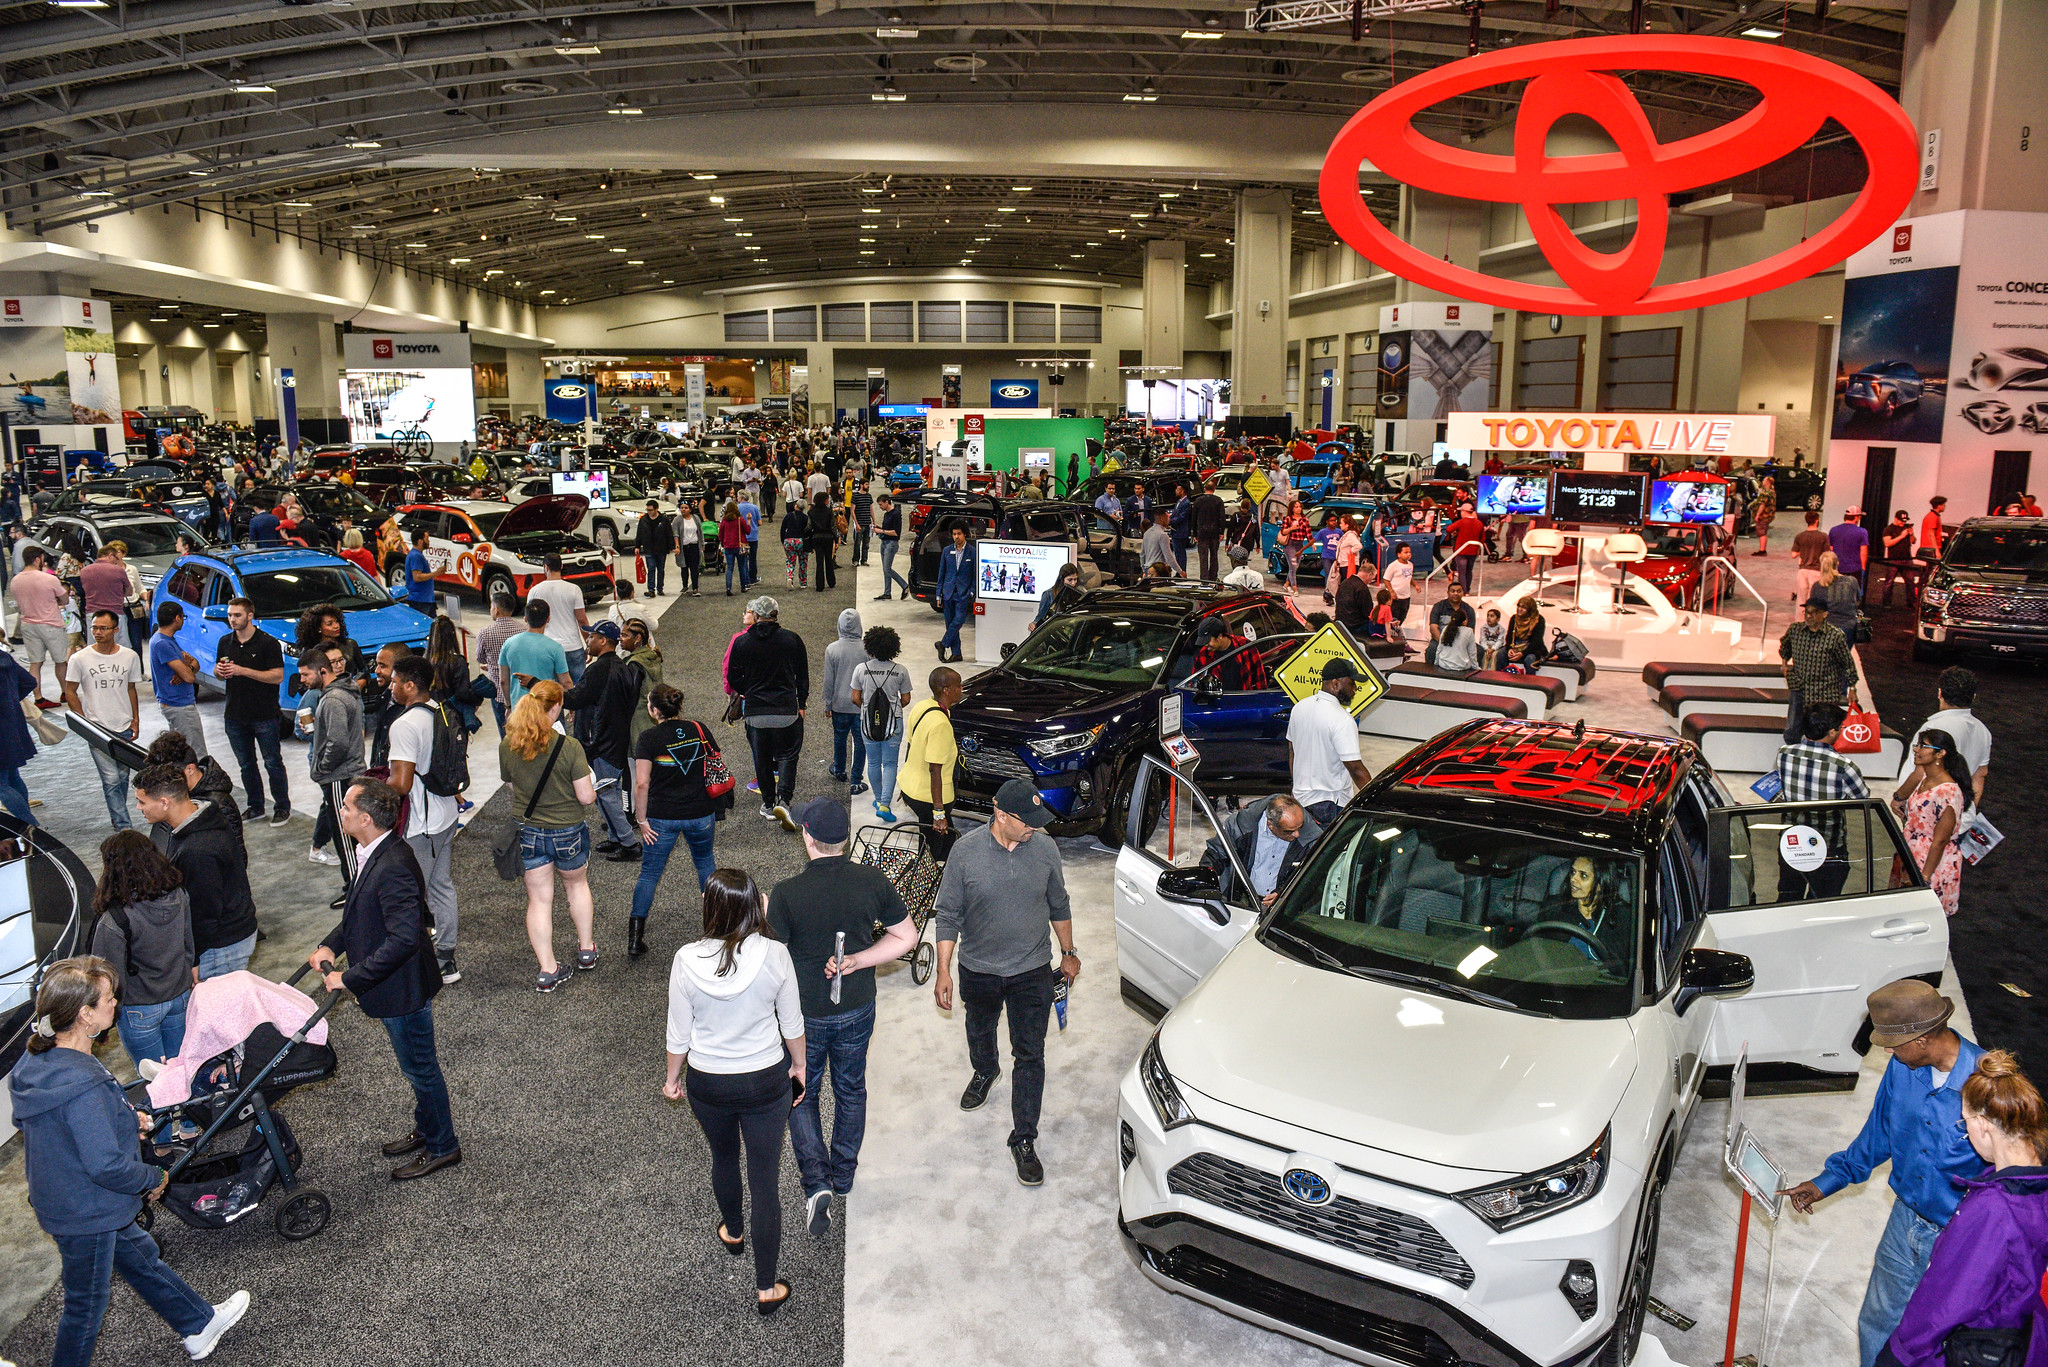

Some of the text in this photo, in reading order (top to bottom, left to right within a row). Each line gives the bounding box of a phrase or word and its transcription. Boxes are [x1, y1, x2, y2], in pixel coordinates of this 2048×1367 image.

[2022, 126, 2030, 138] D
[1929, 133, 1936, 144] D
[2020, 139, 2029, 151] 8
[1928, 146, 1934, 157] 8
[1889, 256, 1912, 265] TOYOTA
[1976, 284, 2003, 292] TOYOTA
[396, 344, 440, 353] TOYOTA
[945, 366, 959, 374] Jeep
[1482, 417, 1735, 451] TOYOTA LIVE
[1561, 486, 1577, 494] Next
[1578, 486, 1610, 495] ToyotaLive
[1579, 494, 1616, 507] 21:28
[999, 547, 1048, 557] TOYOTA LIVE
[1314, 648, 1344, 657] CAUTION
[1990, 644, 2016, 652] TRD
[89, 663, 128, 677] AE-NY
[94, 678, 124, 689] 1977
[272, 1049, 290, 1068] CRUZ
[282, 1069, 324, 1082] UPPAbaby
